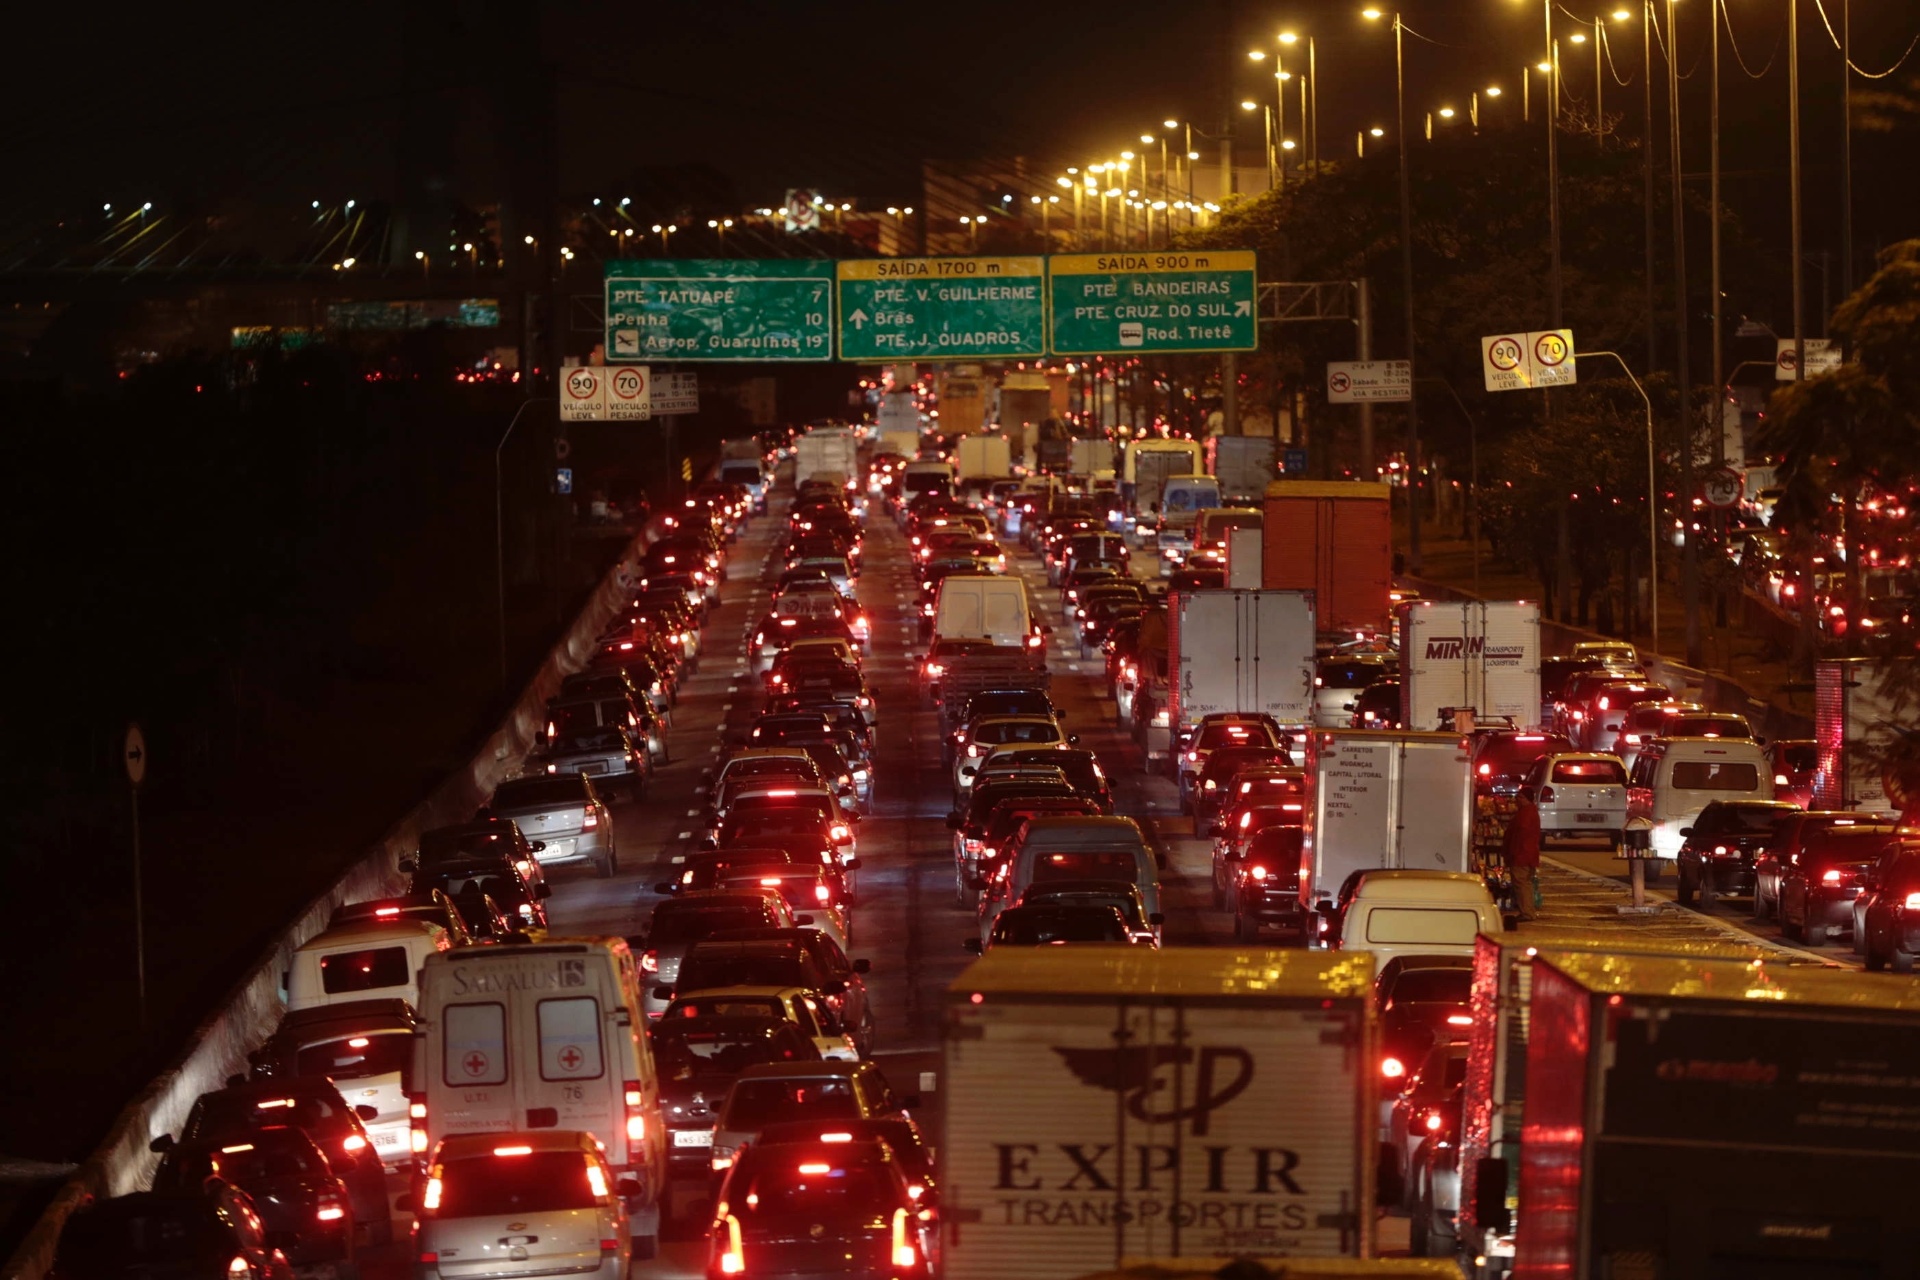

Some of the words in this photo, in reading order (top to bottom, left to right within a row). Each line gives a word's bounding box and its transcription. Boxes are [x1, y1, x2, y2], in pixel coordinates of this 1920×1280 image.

[878, 263, 928, 275] SAÍDA
[937, 262, 976, 274] 1700
[986, 264, 999, 273] m
[1097, 255, 1148, 270] SAÍDA
[1156, 256, 1189, 268] 900
[1195, 258, 1209, 268] m
[614, 291, 648, 303] PTE.
[658, 288, 734, 303] TATUAPÉ
[812, 291, 821, 303] 7
[875, 290, 909, 303] PTE.
[916, 289, 931, 301] V.
[939, 287, 1035, 300] GUILHERME
[1084, 284, 1117, 297] PTE.
[1134, 281, 1230, 295] BANDEIRAS
[1075, 306, 1109, 319] PTE.
[1169, 304, 1191, 317] DO
[1198, 303, 1231, 316] SUL
[614, 313, 668, 326] Penha
[805, 313, 823, 326] 10
[938, 332, 1020, 346] QUADROS
[1147, 327, 1182, 340] Rod.
[1188, 325, 1232, 339] Tietê
[709, 335, 799, 348] Guarulhos
[806, 336, 823, 347] 19
[1496, 346, 1516, 359] 90
[1541, 342, 1562, 355] 70
[572, 378, 593, 390] 90
[618, 377, 638, 390] 70
[1499, 380, 1517, 389] LEVE
[1540, 376, 1568, 385] PESADO
[1372, 389, 1409, 397] RESTRITA
[610, 411, 647, 419] PESADO
[1425, 636, 1486, 659] MIRIN
[1340, 761, 1373, 769] MUDANÇAS
[564, 1086, 582, 1099] 76
[993, 1143, 1307, 1196] EXPIR
[999, 1200, 1307, 1231] TRANSPORTES
